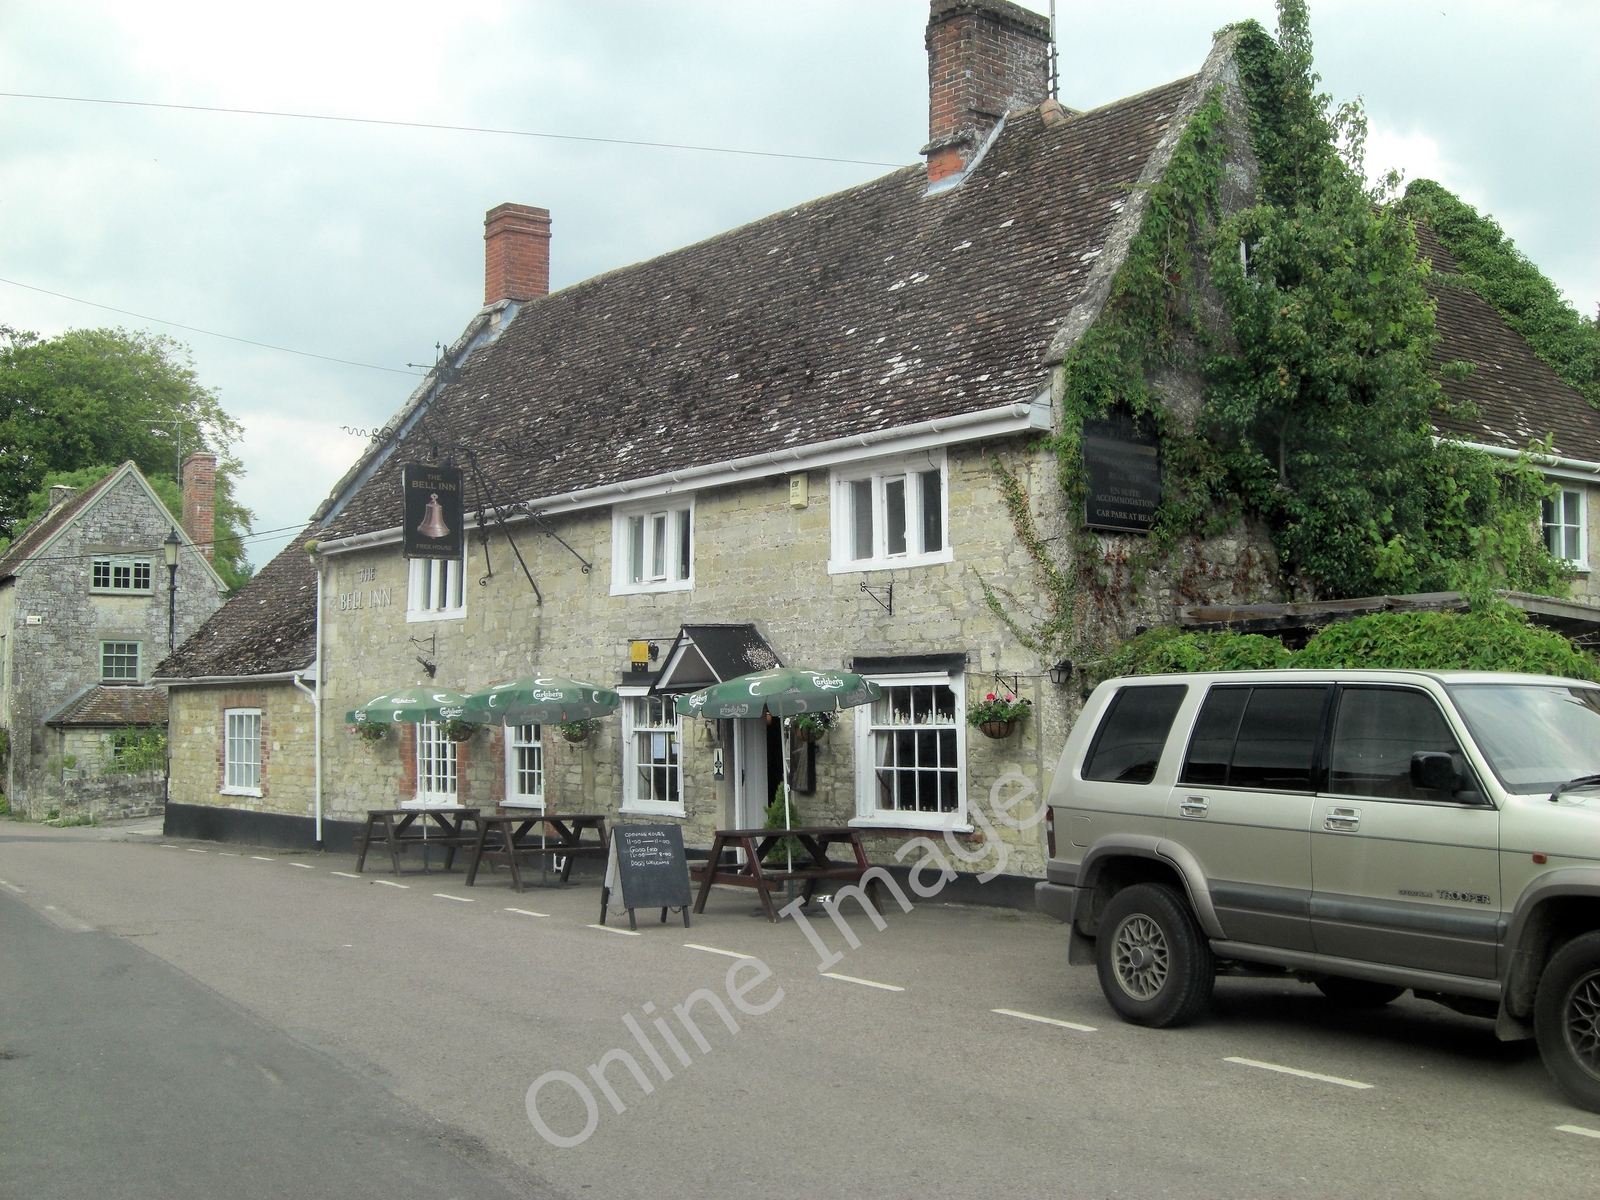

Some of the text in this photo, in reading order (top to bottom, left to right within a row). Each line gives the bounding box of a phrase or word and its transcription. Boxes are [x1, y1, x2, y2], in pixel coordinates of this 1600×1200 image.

[412, 481, 456, 491] BELL INN
[1121, 488, 1141, 498] SUITE
[1096, 494, 1155, 508] ACCOMMODATION
[1096, 508, 1110, 517] CAR
[1111, 510, 1128, 520] PARK
[359, 568, 376, 582] THE
[340, 588, 392, 611] BELL INN
[812, 676, 844, 690] Carlsberg
[533, 688, 563, 702] Carlsberg
[1436, 888, 1490, 904] TROOPER
